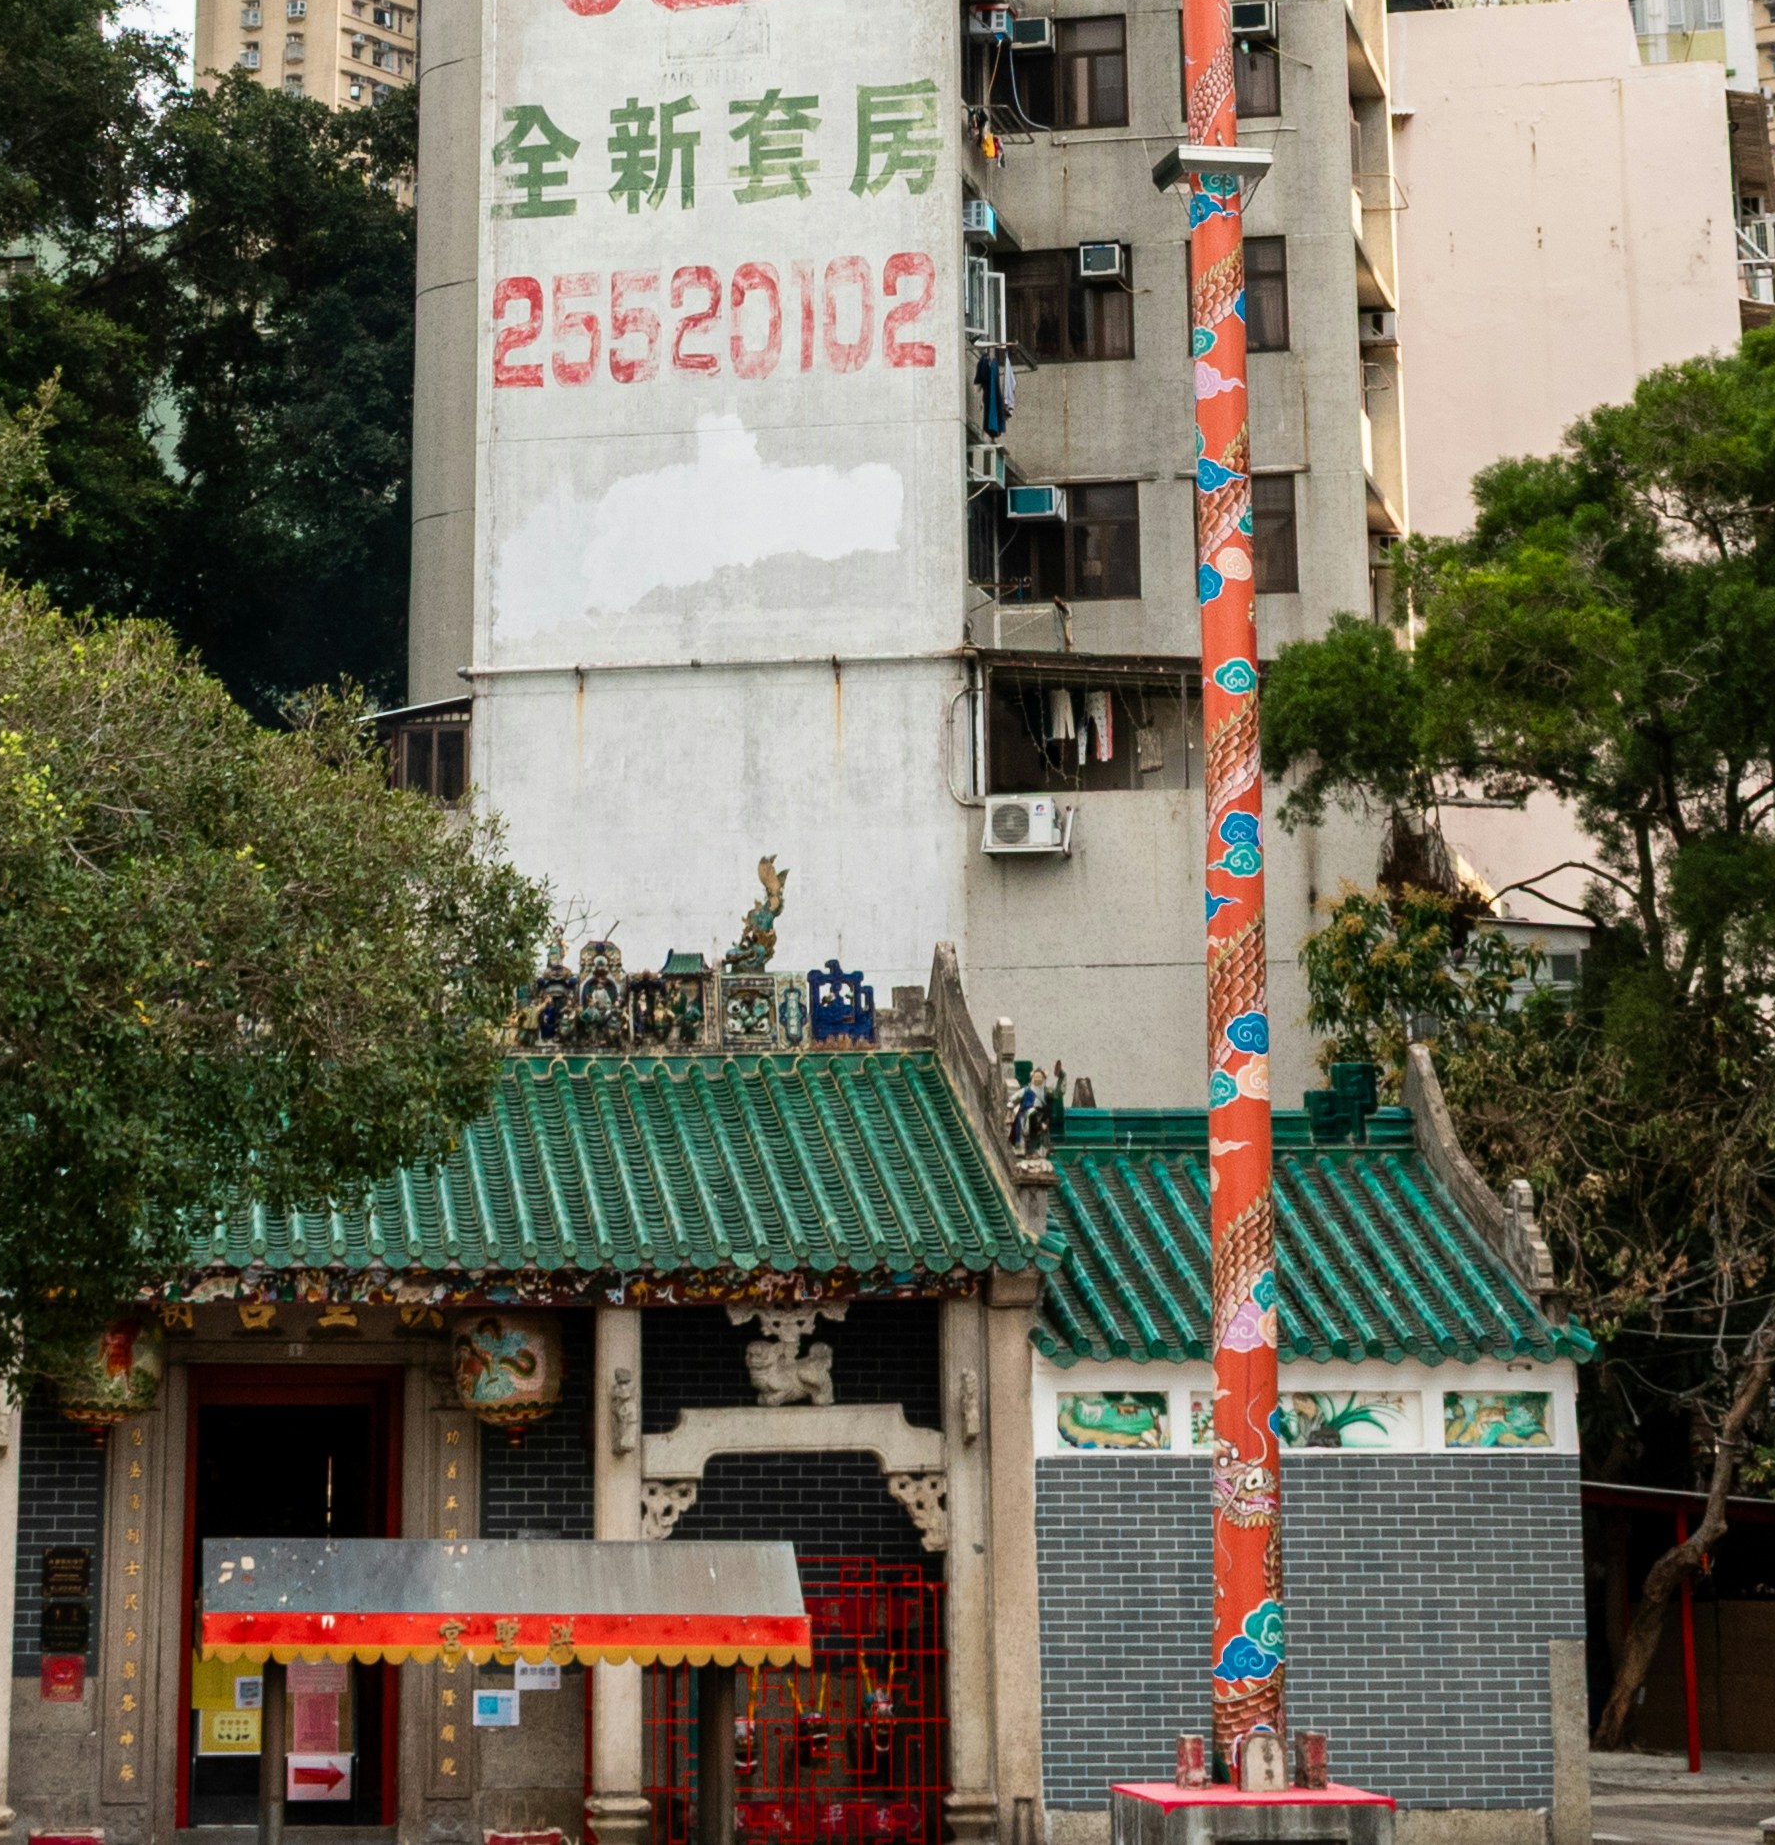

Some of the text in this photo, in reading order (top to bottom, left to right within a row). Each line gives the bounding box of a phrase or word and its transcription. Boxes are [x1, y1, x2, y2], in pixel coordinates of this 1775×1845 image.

[491, 79, 944, 220] 全新套房
[492, 251, 936, 389] 25520102
